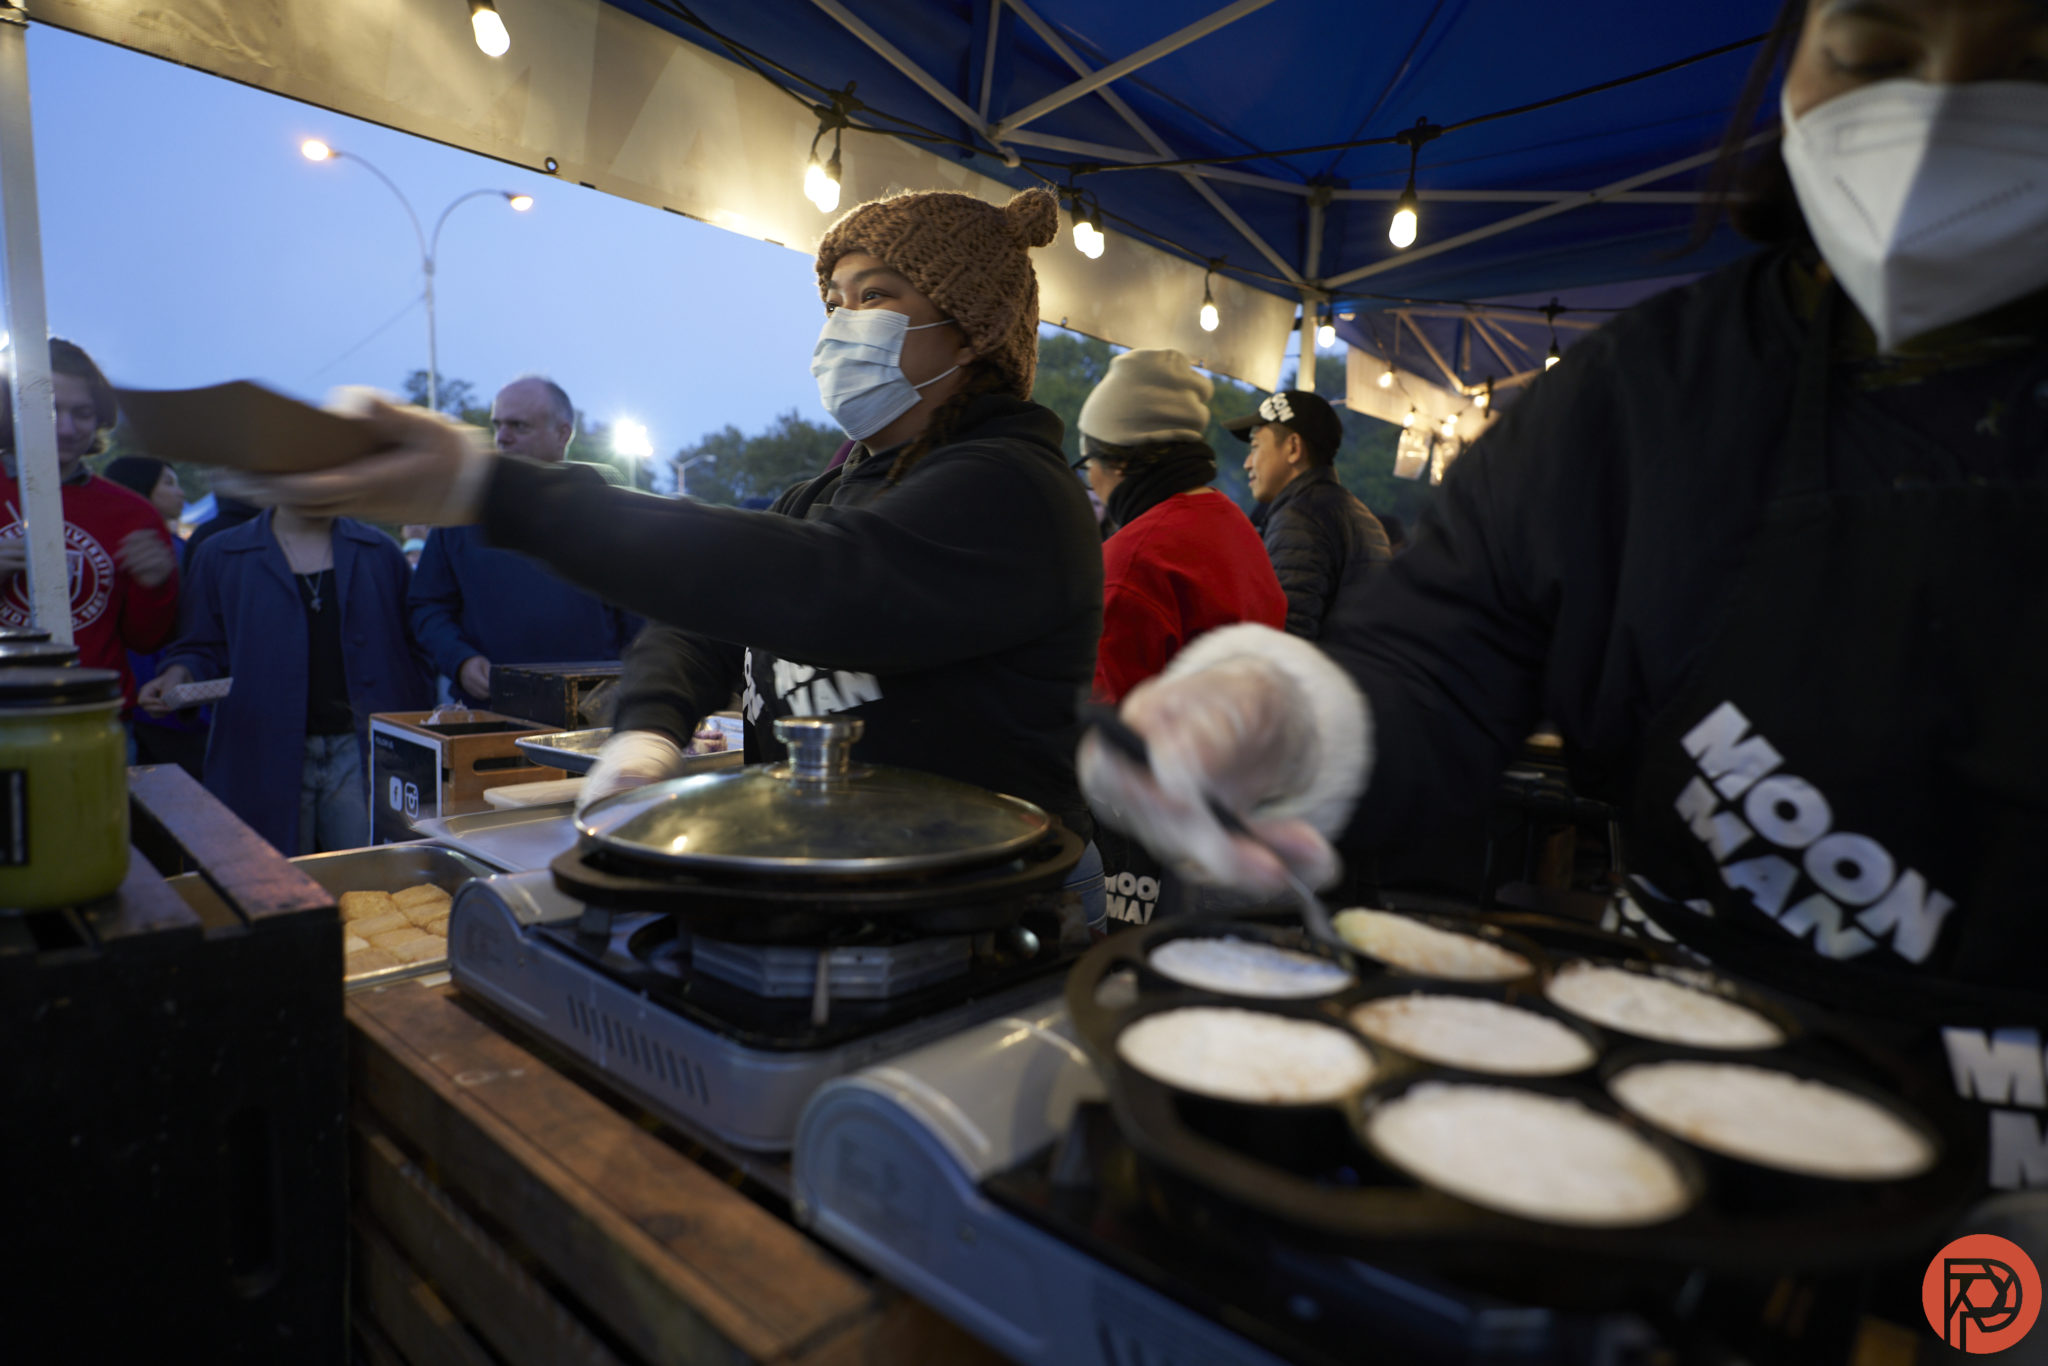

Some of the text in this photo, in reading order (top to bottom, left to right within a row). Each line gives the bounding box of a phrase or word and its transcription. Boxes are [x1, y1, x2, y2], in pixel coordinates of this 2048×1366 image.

[65, 525, 111, 587] IVERSITY
[1674, 776, 1877, 959] MAN
[1680, 700, 1955, 965] MOON
[1104, 872, 1160, 903] MOO
[1941, 1026, 2048, 1108] M
